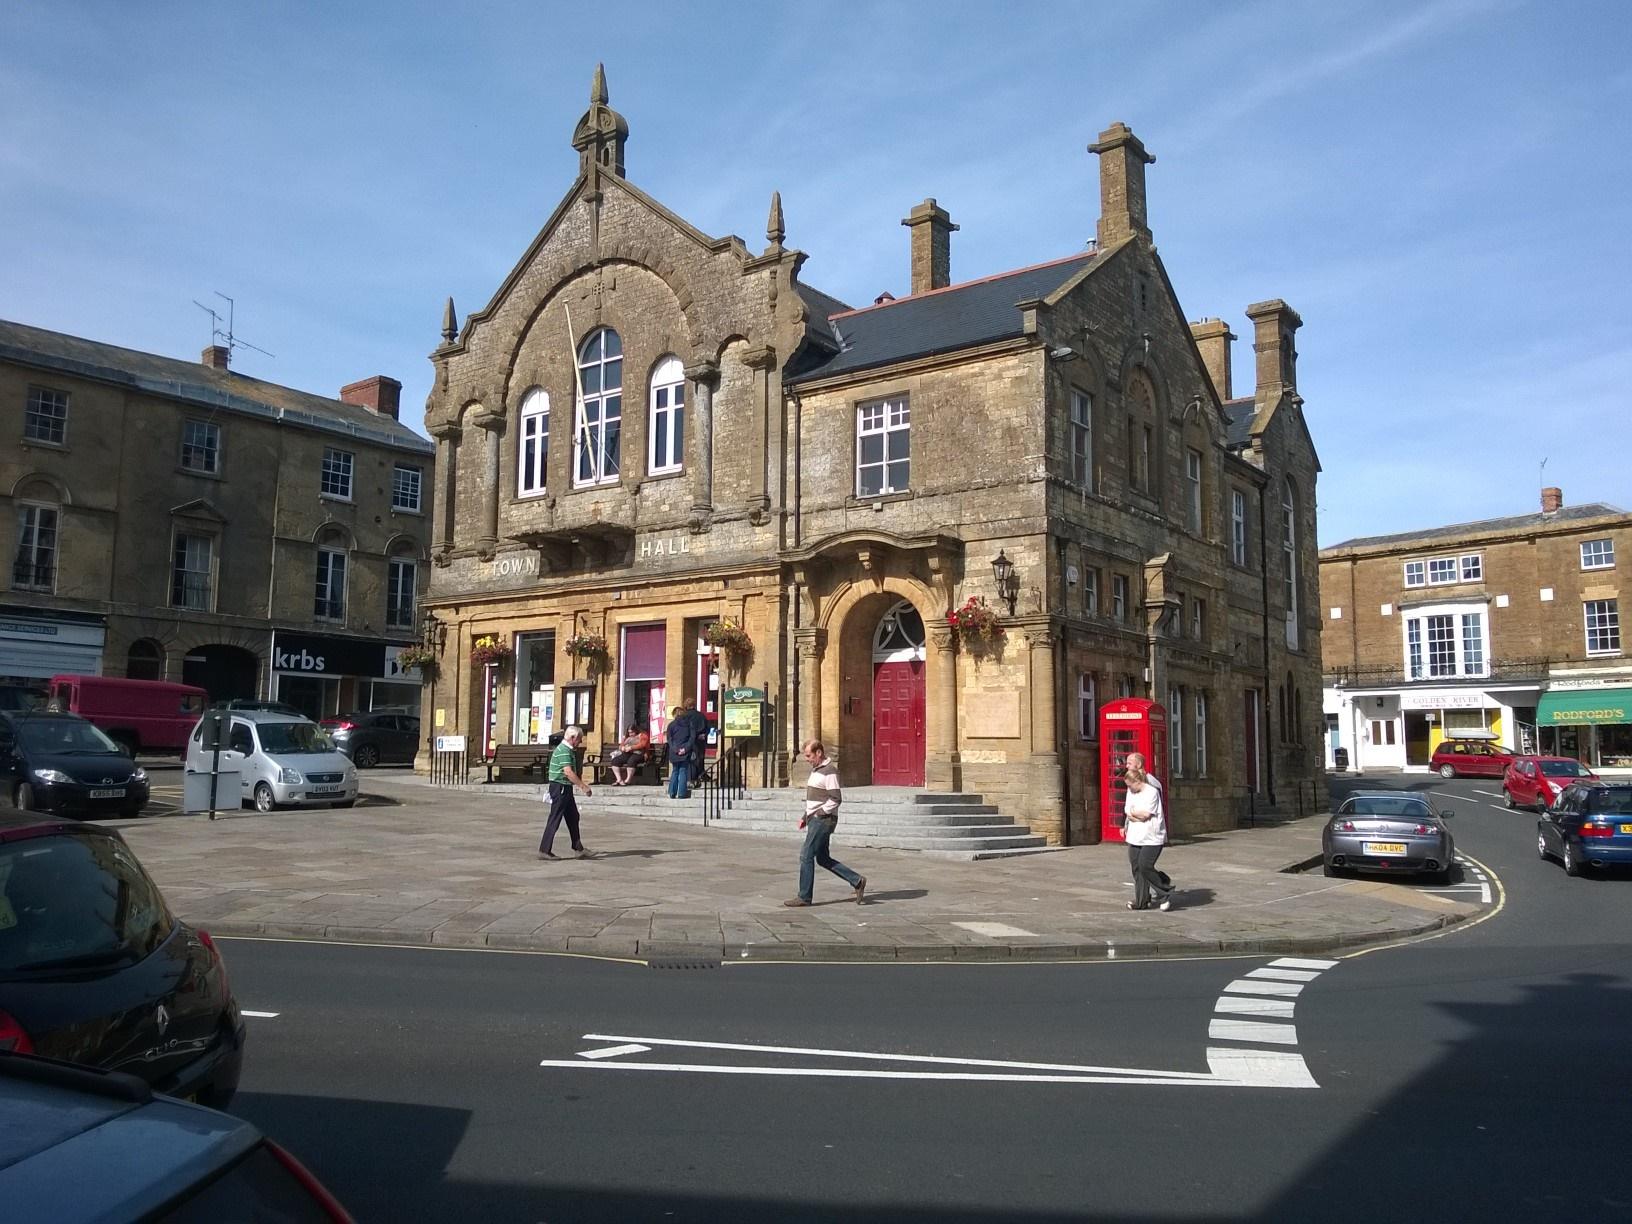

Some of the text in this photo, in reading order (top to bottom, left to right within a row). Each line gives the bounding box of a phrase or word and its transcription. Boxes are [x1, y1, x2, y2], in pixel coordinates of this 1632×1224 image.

[492, 537, 689, 576] TOWN HALL
[275, 646, 325, 671] krbs
[1553, 709, 1625, 720] RODFORD'S
